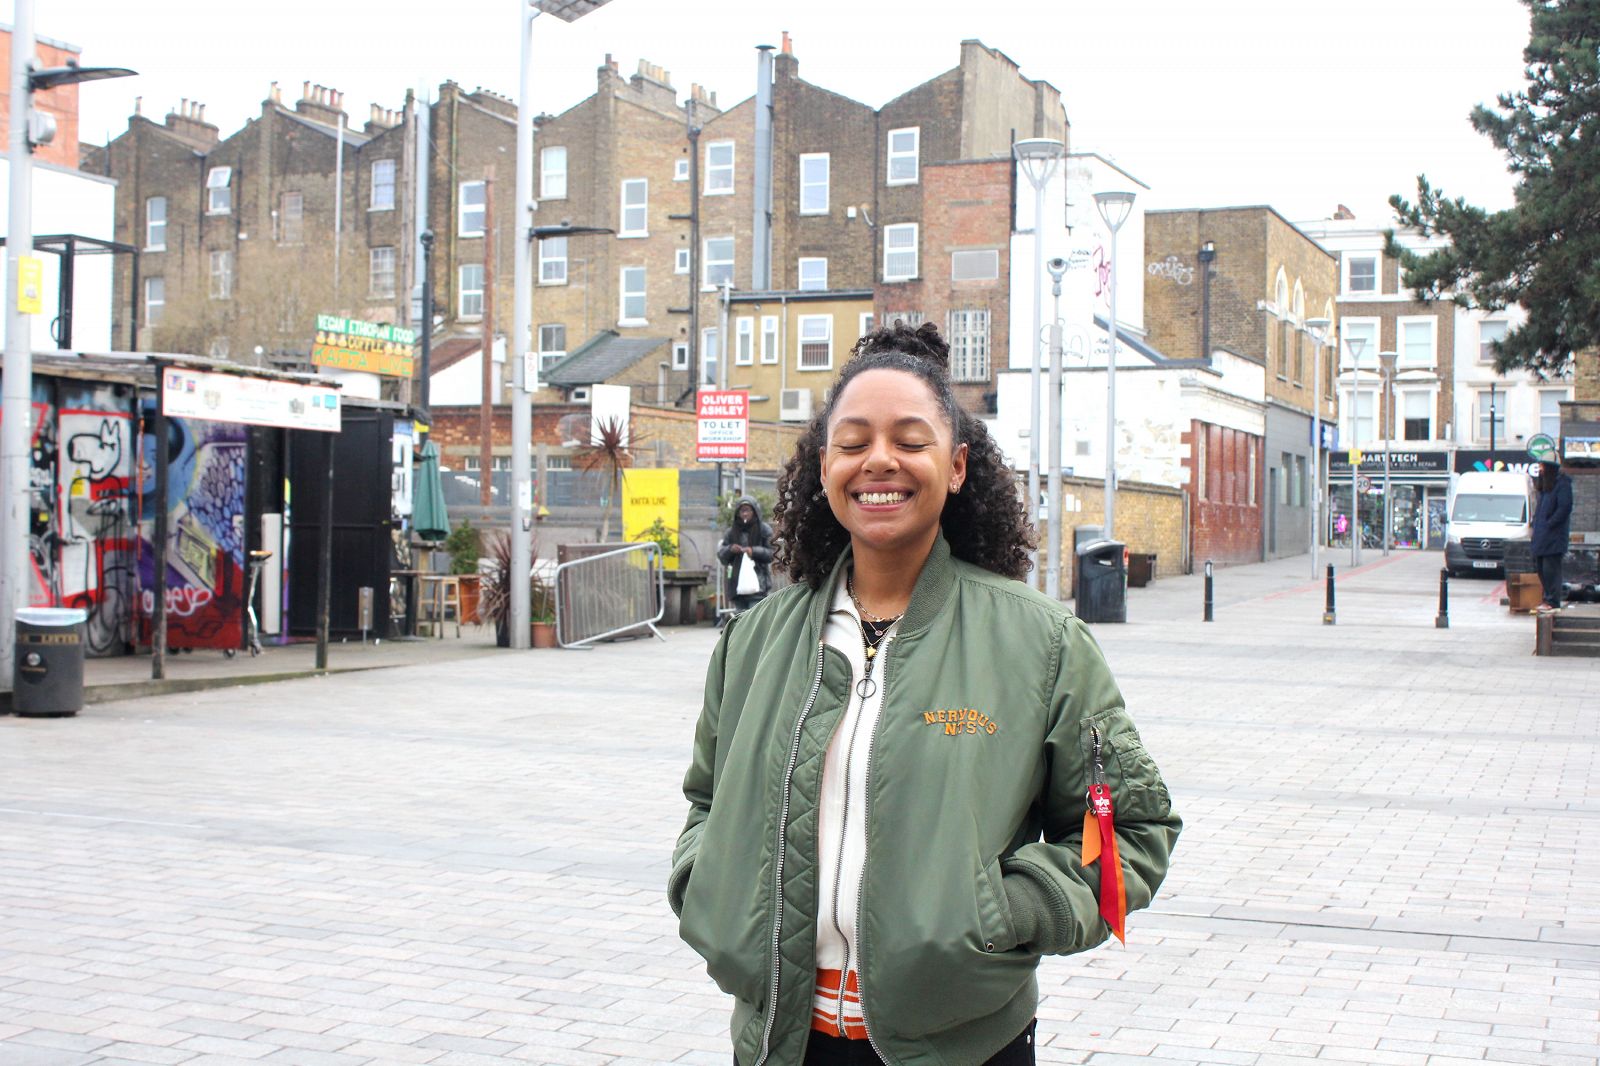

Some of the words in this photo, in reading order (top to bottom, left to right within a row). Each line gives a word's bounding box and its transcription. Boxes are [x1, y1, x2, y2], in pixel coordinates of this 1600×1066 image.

[318, 314, 346, 334] VEGAN
[392, 327, 415, 344] FOOD
[702, 395, 743, 405] OLIVER
[700, 406, 744, 416] ASHLEY
[703, 421, 717, 429] TO
[720, 421, 741, 429] LET
[1390, 454, 1418, 463] TECH
[1357, 480, 1368, 488] 20
[923, 708, 998, 736] NERVOUS
[945, 721, 977, 736] NTS
